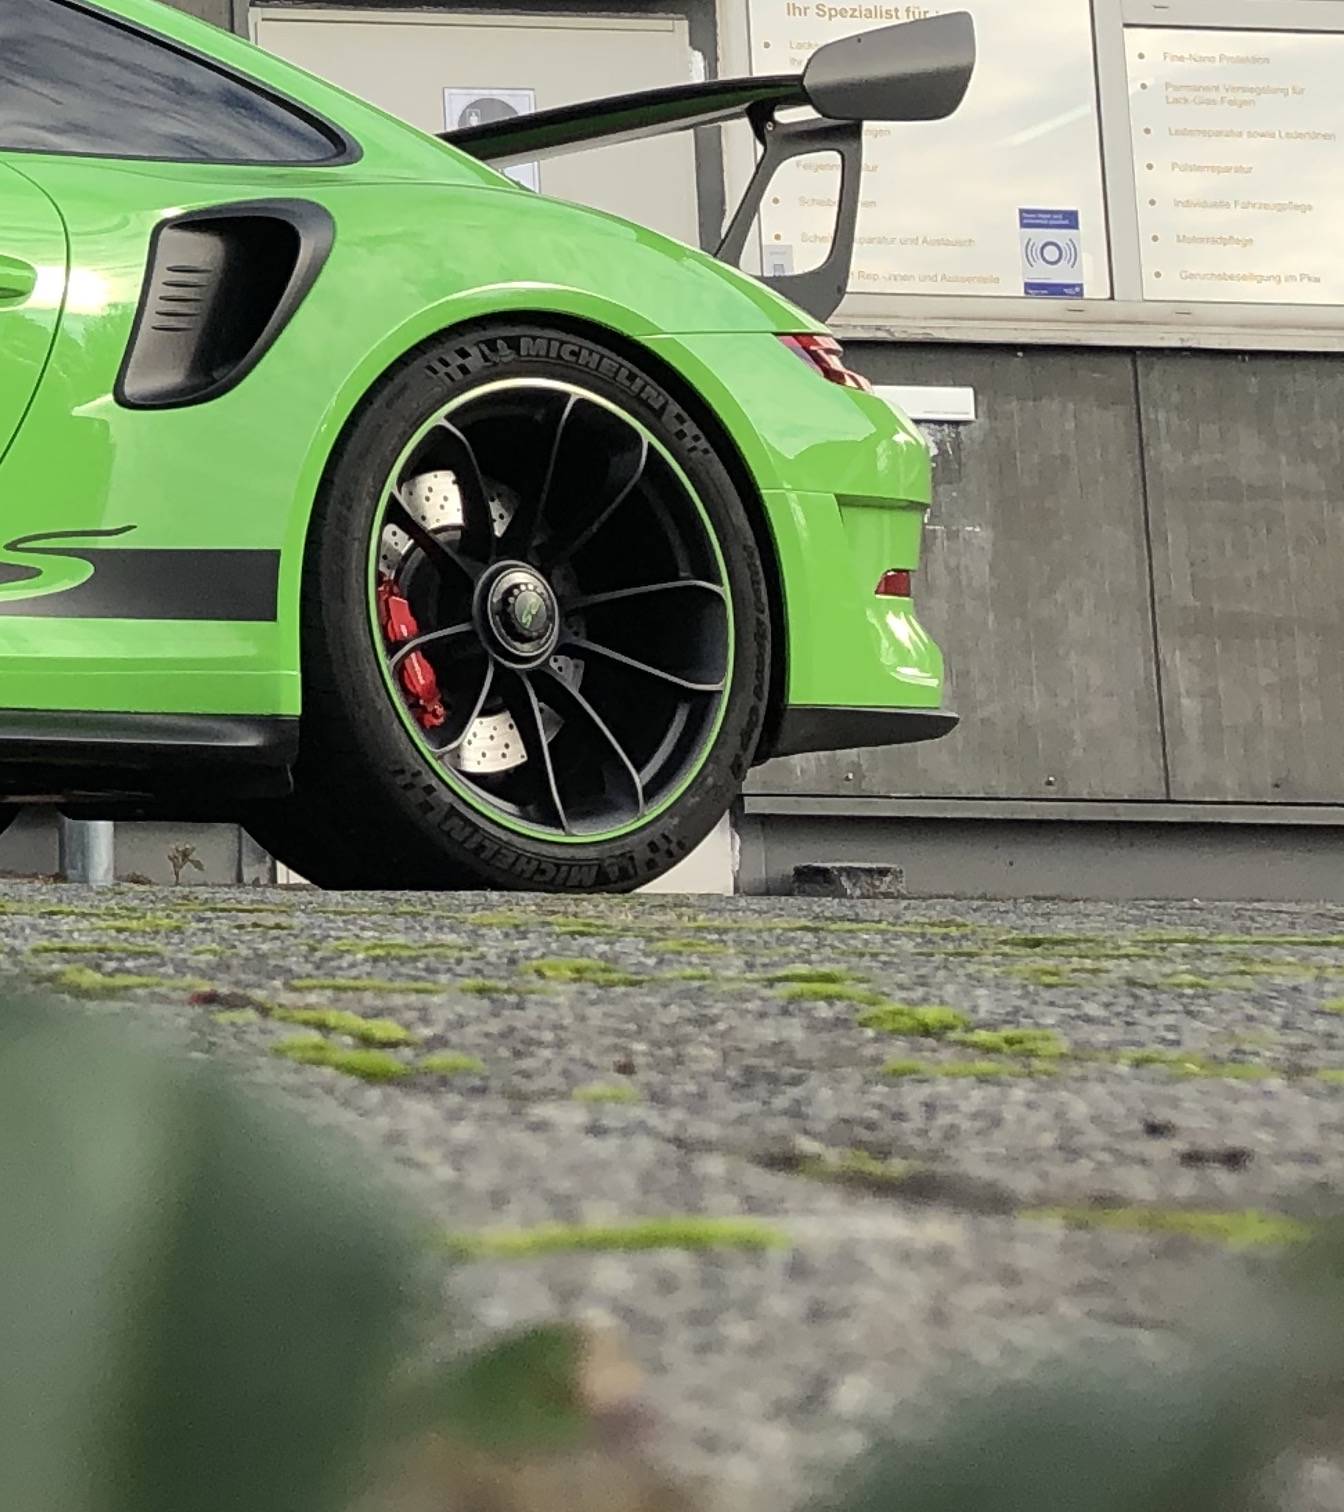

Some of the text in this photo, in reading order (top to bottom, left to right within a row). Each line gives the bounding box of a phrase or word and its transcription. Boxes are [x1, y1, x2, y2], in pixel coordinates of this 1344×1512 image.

[786, 2, 930, 21] Ihr Spezialist für
[519, 337, 664, 410] MICHELIN
